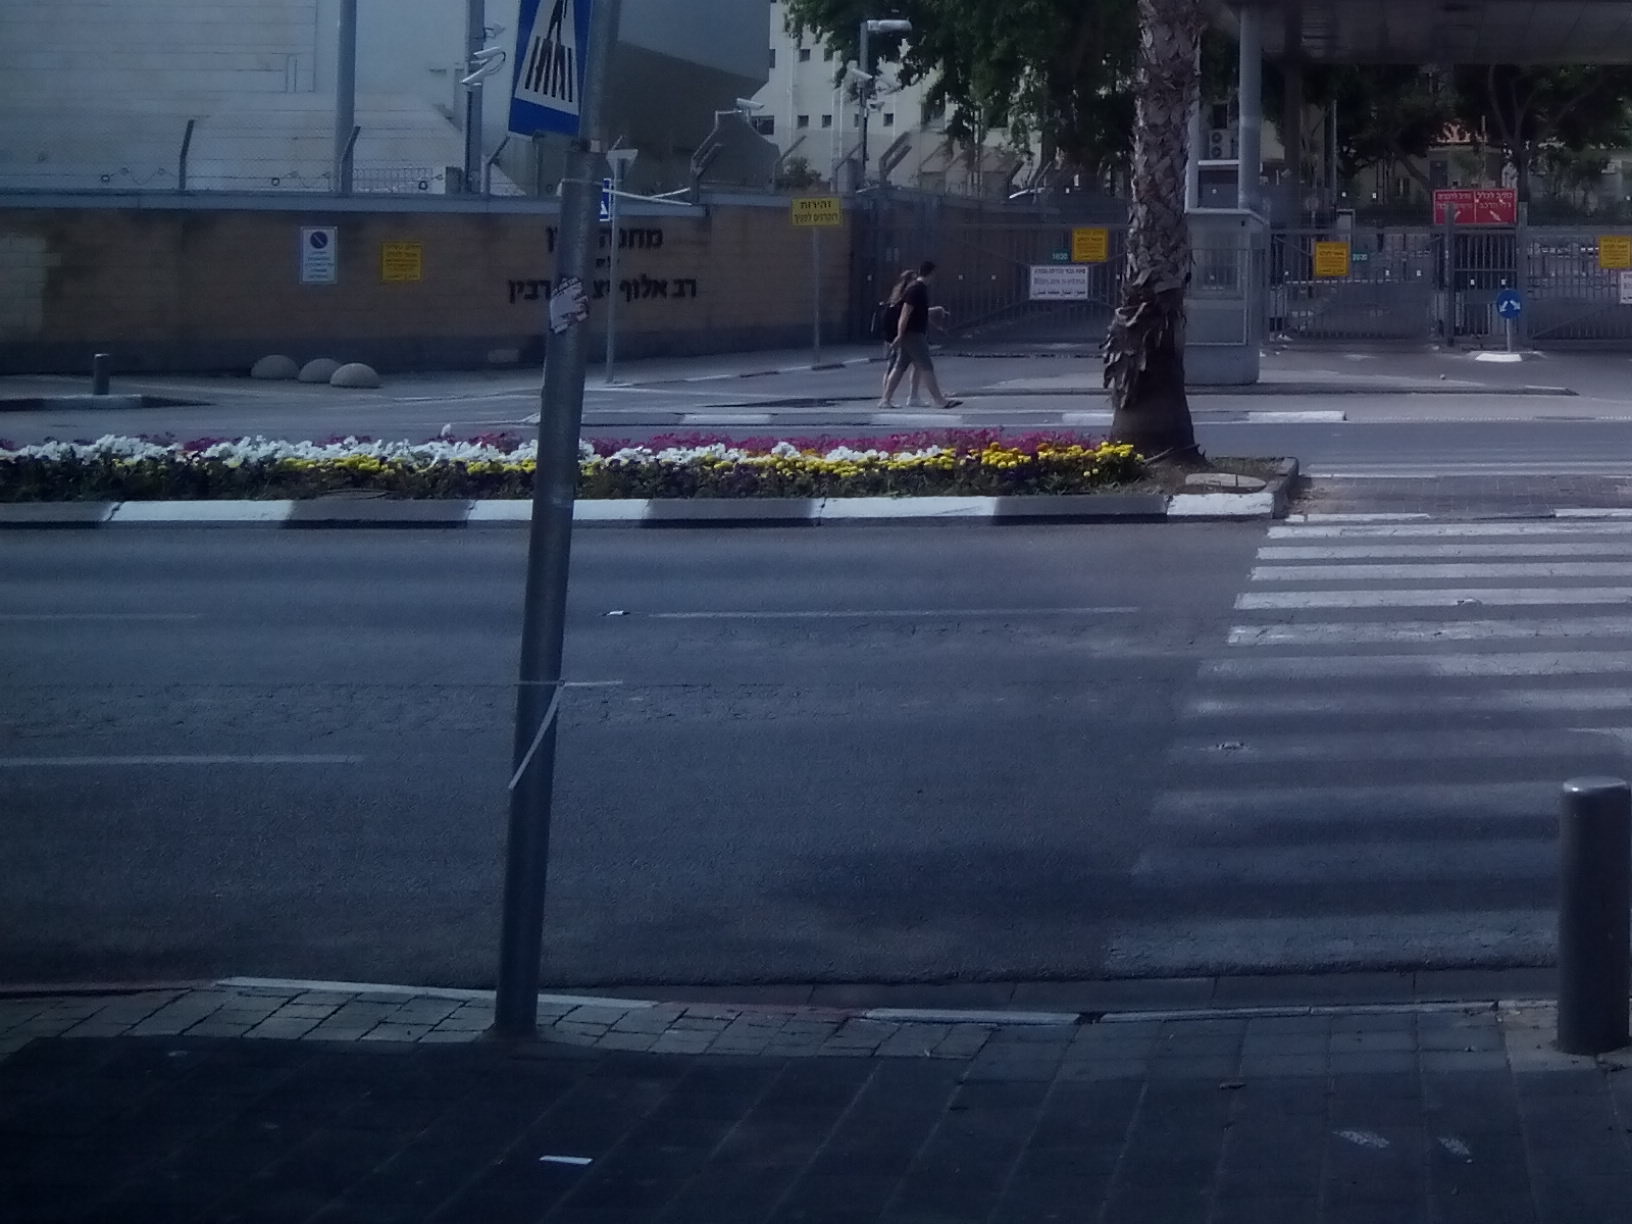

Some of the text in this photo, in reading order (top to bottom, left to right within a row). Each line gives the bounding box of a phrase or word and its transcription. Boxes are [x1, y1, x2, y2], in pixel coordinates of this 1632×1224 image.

[800, 199, 832, 209] זהירות
[620, 273, 668, 303] אלוף
[672, 278, 697, 297] רב
